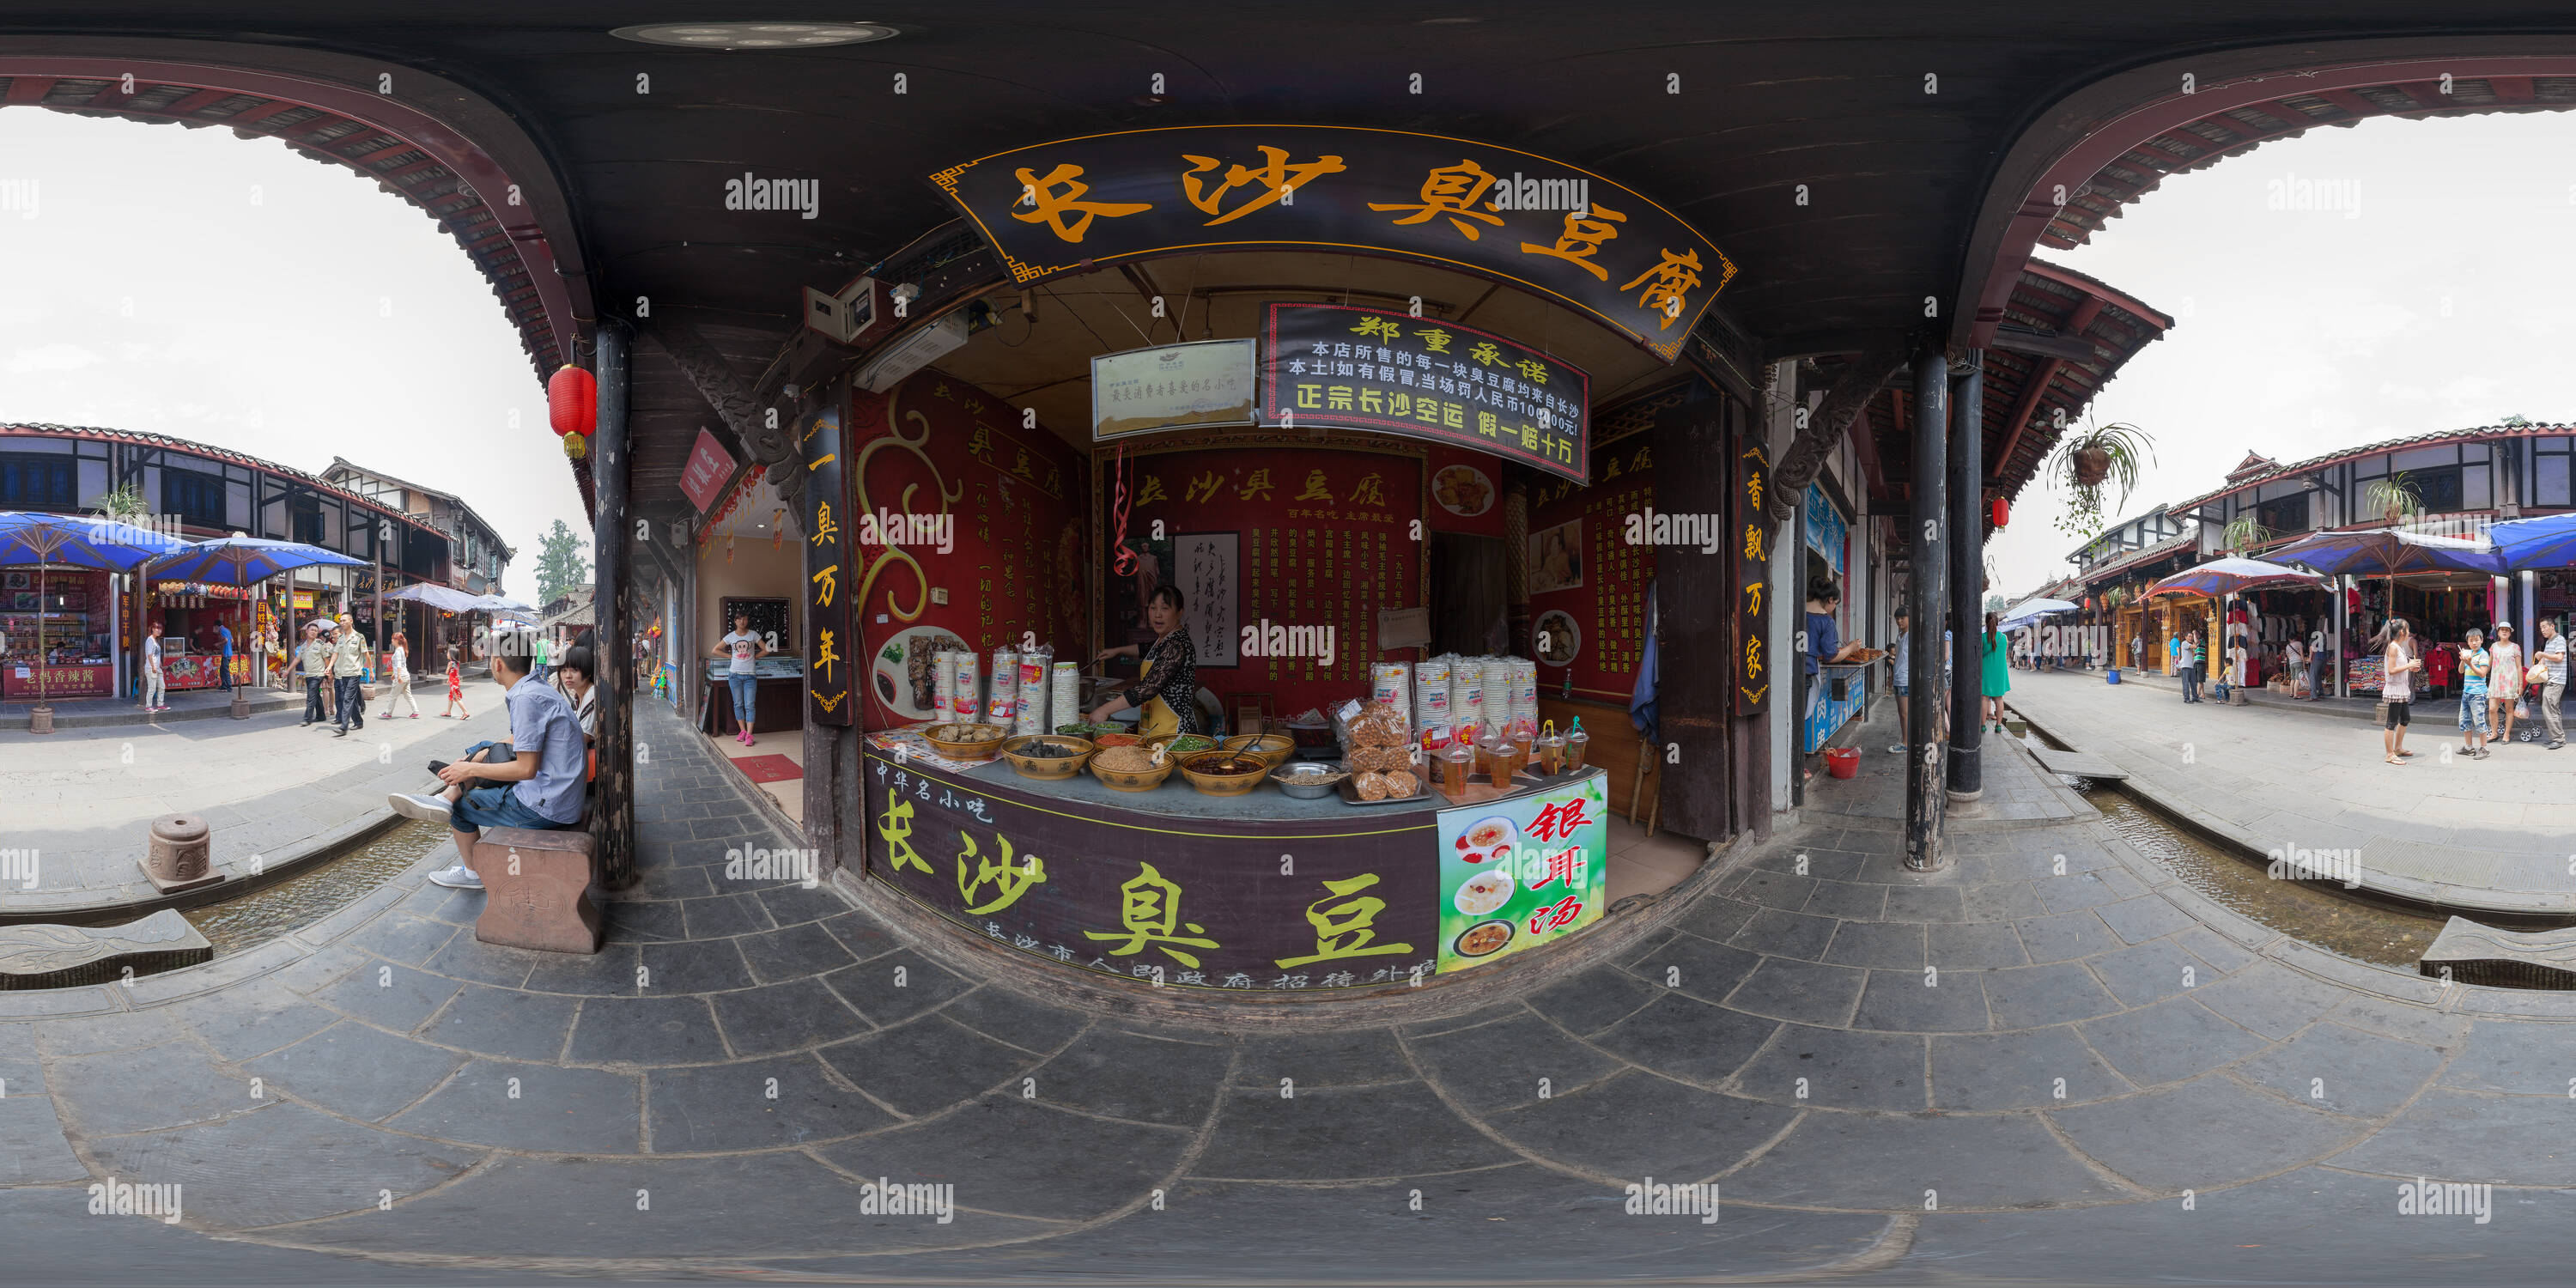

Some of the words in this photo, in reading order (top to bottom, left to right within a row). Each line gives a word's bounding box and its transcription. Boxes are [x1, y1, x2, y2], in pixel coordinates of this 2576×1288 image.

[1012, 144, 1703, 330] 长沙臭豆腐
[1312, 341, 1579, 418] 本店所售的每一块臭豆腐均来自长沙
[1349, 316, 1549, 385] 郑重承诺
[1297, 384, 1462, 428] 正宗长沙空运
[1478, 410, 1572, 464] 假一赔十万
[1136, 468, 1386, 507] 长沙臭豆腐
[808, 453, 841, 684] 一臭万年
[1744, 471, 1766, 680] 香飘万家
[877, 761, 993, 823] 中华名小吃
[878, 787, 1413, 969] 长沙臭豆
[1524, 798, 1593, 936] 银耳汤
